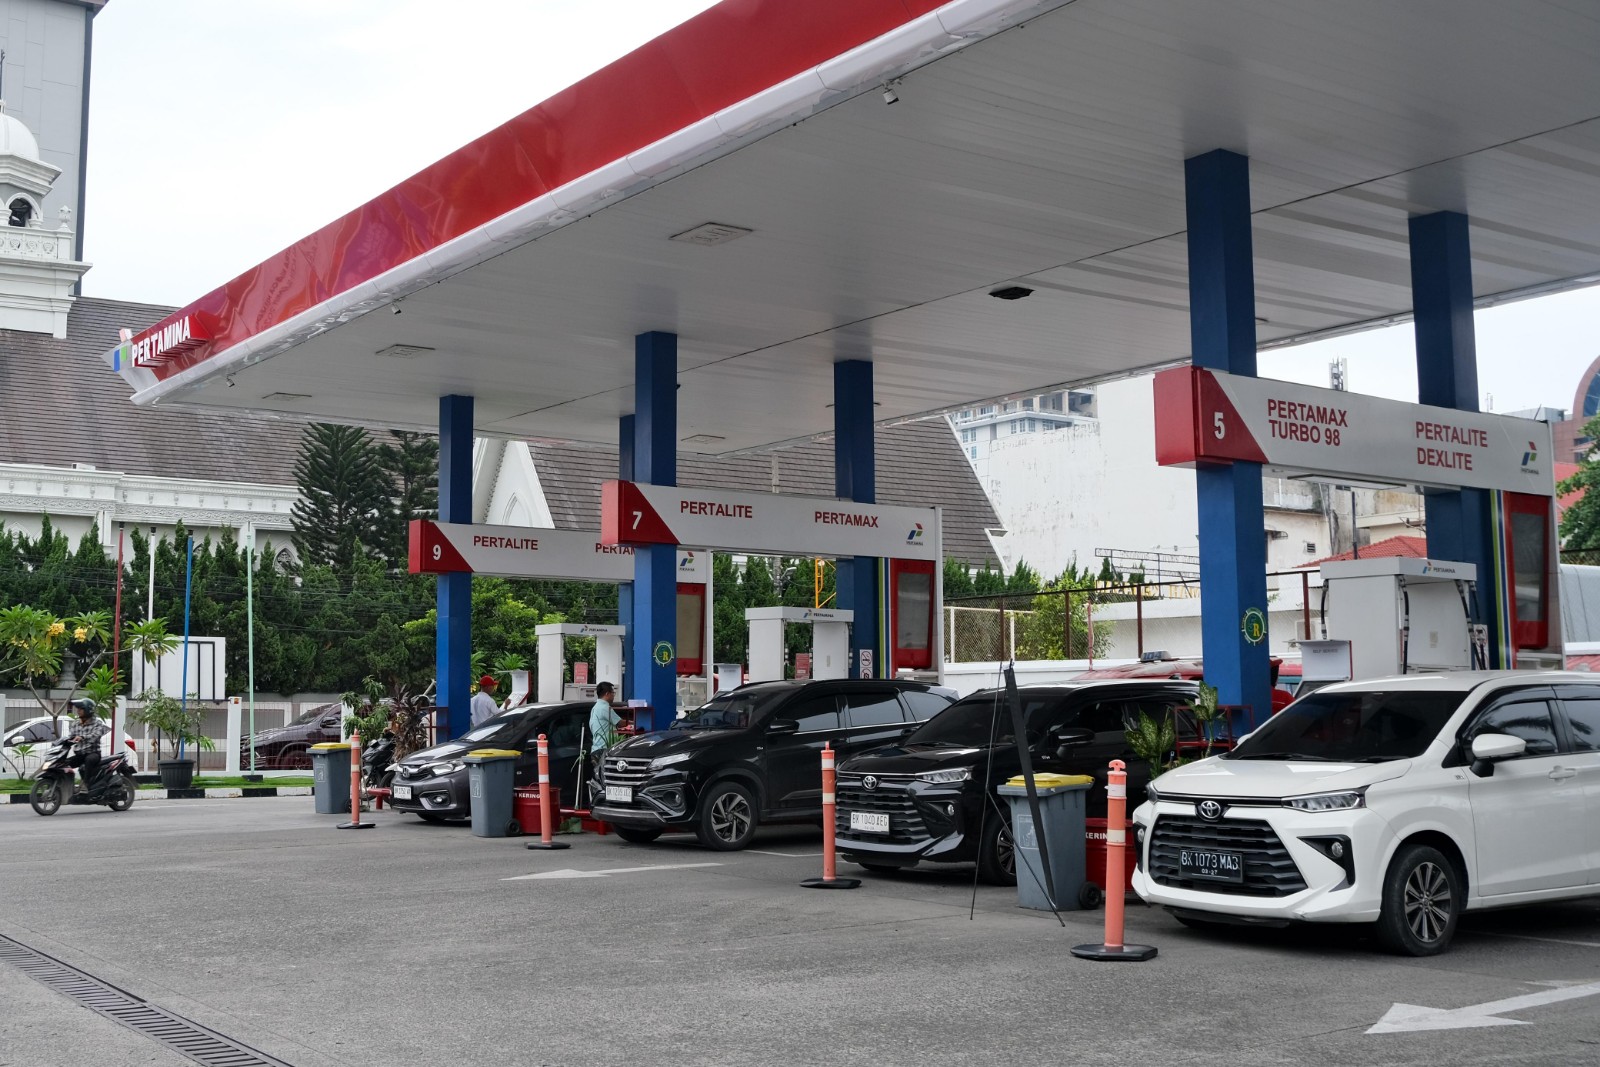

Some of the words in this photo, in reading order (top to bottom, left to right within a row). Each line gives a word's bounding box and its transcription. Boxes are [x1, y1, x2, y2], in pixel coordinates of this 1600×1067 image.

[131, 315, 191, 368] PERTAMINA
[1267, 398, 1348, 428] PERTAMAX
[1213, 411, 1226, 440] 5
[1268, 419, 1320, 444] TURBO
[1324, 427, 1341, 447] 98
[1415, 421, 1488, 448] PERTALITE
[1416, 447, 1473, 471] DEXLITE
[632, 510, 643, 530] 7
[680, 500, 753, 519] PERTALITE
[814, 511, 879, 529] PERTAMAX
[432, 544, 442, 561] 9
[473, 535, 539, 551] PERTALITE
[1181, 851, 1193, 866] BK
